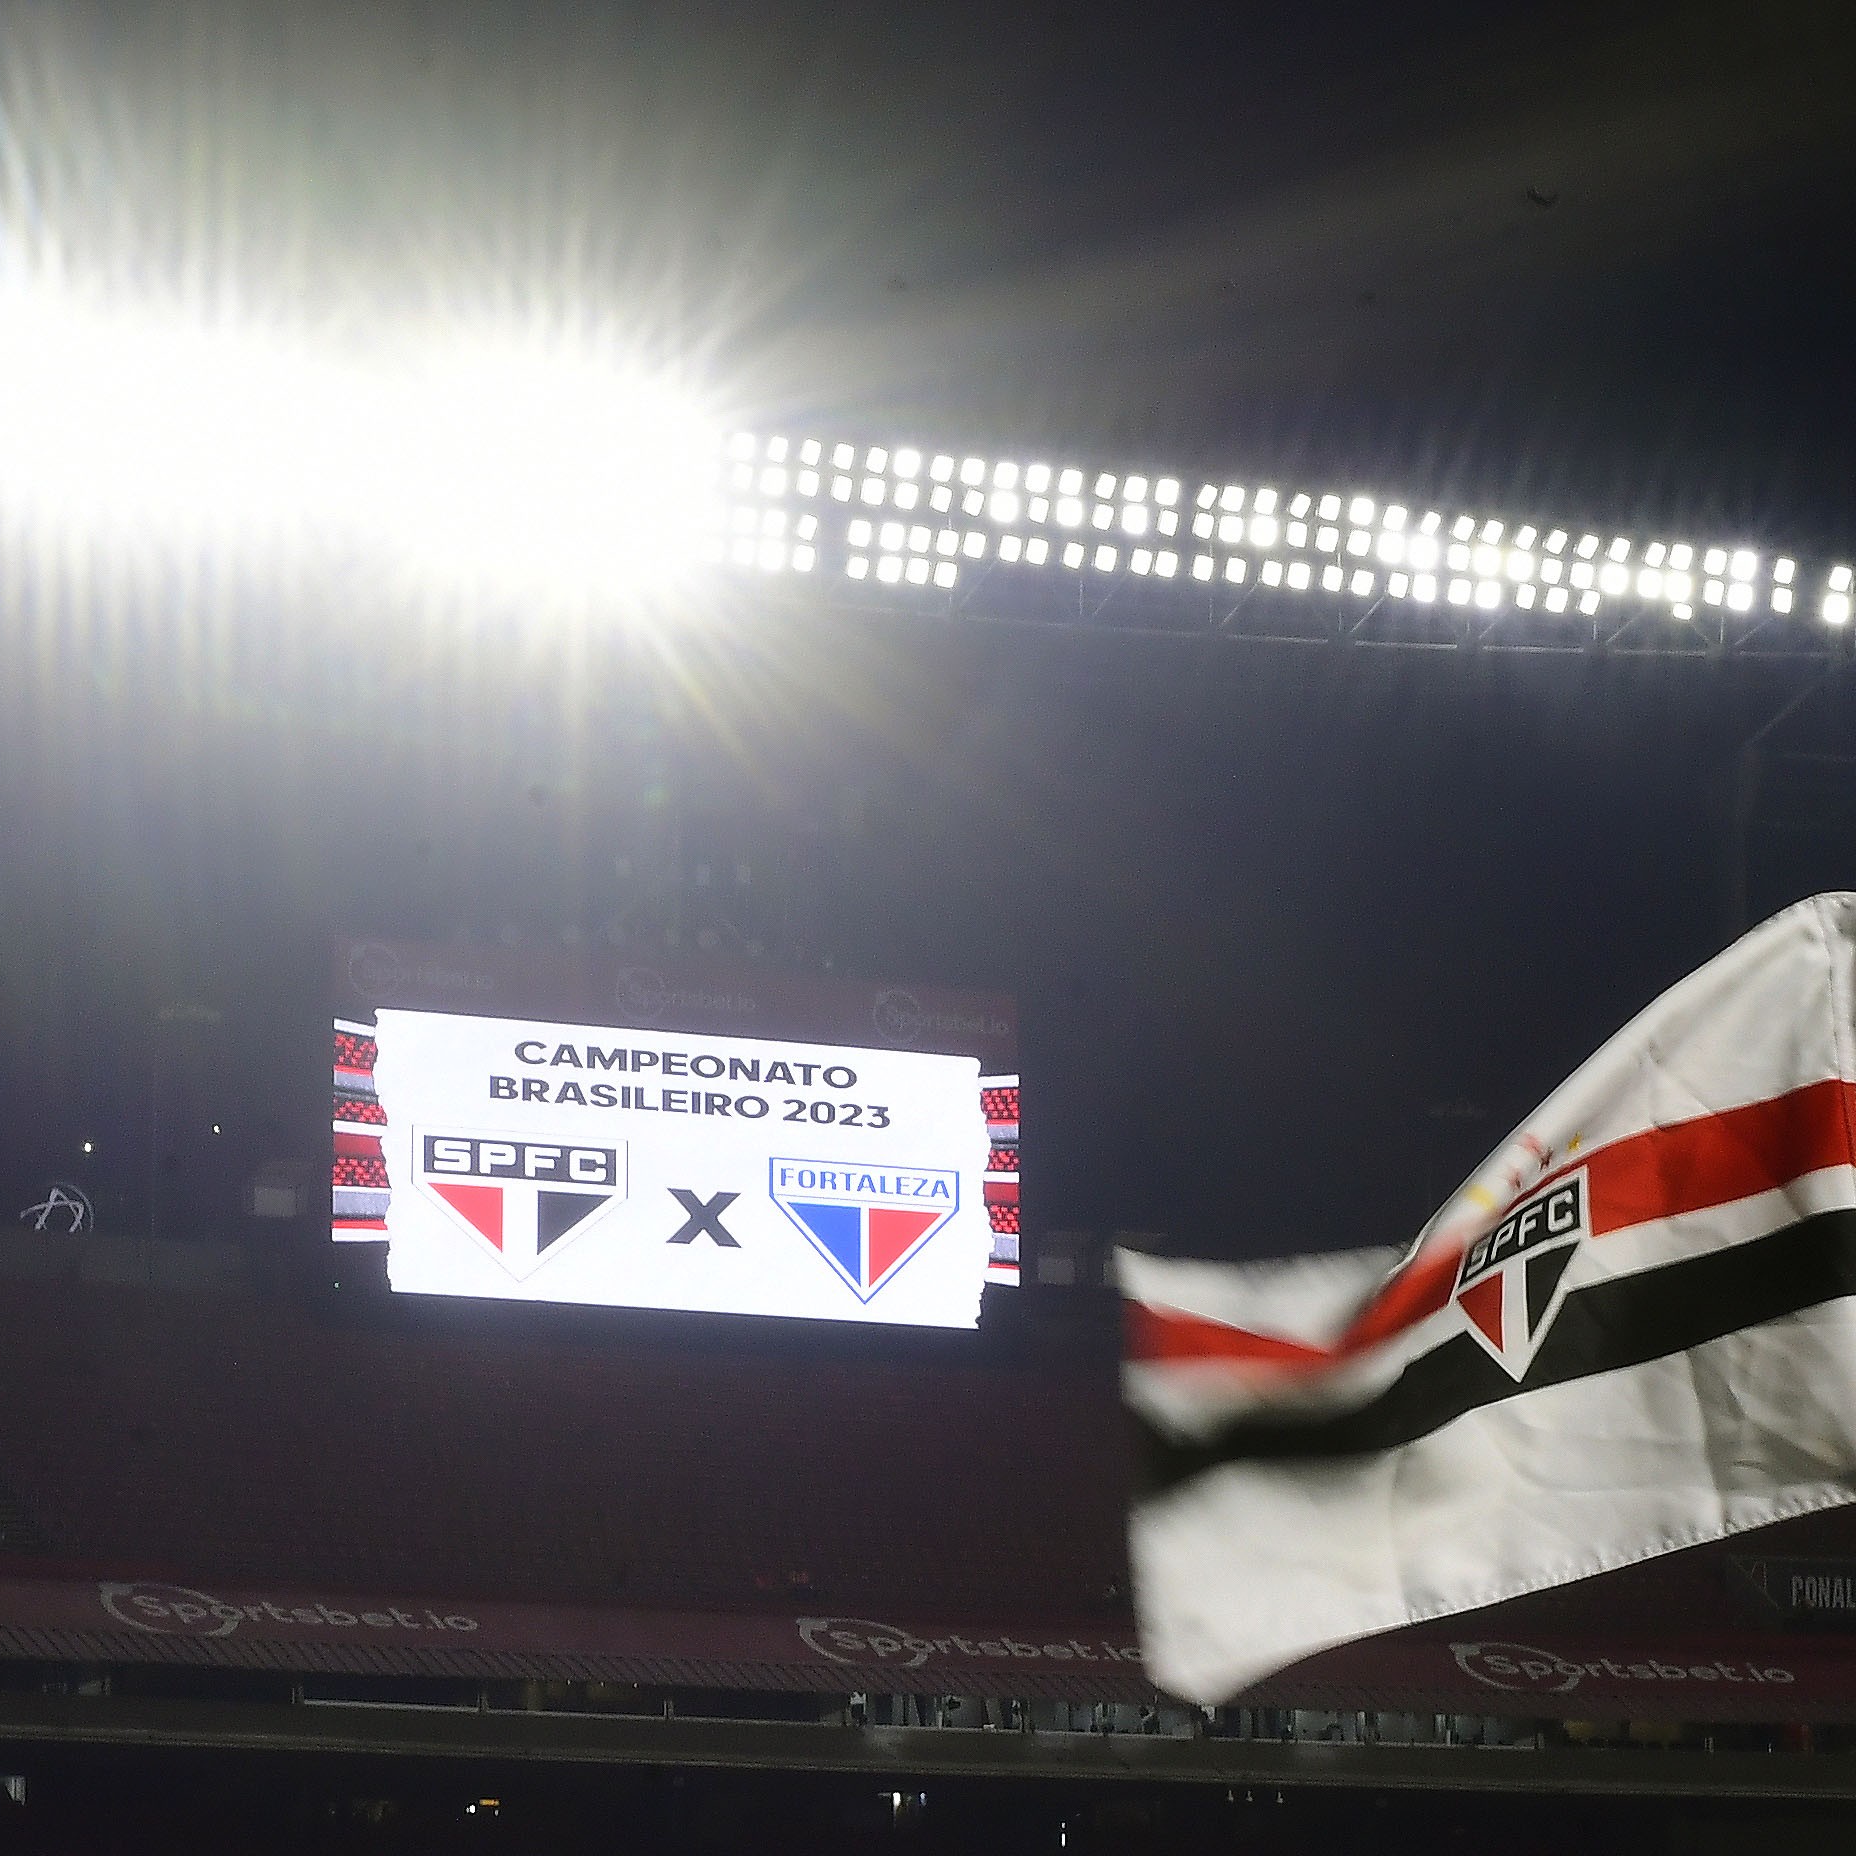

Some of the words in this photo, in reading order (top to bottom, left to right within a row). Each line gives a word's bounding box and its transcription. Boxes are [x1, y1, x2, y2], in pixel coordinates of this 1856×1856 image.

[515, 1040, 857, 1089] CAMPEONATO
[489, 1075, 769, 1121] BRASILEIRO
[783, 1099, 890, 1130] 2023
[433, 1138, 608, 1182] SPFC
[780, 1166, 950, 1201] FORTALEZA
[666, 1188, 742, 1248] X
